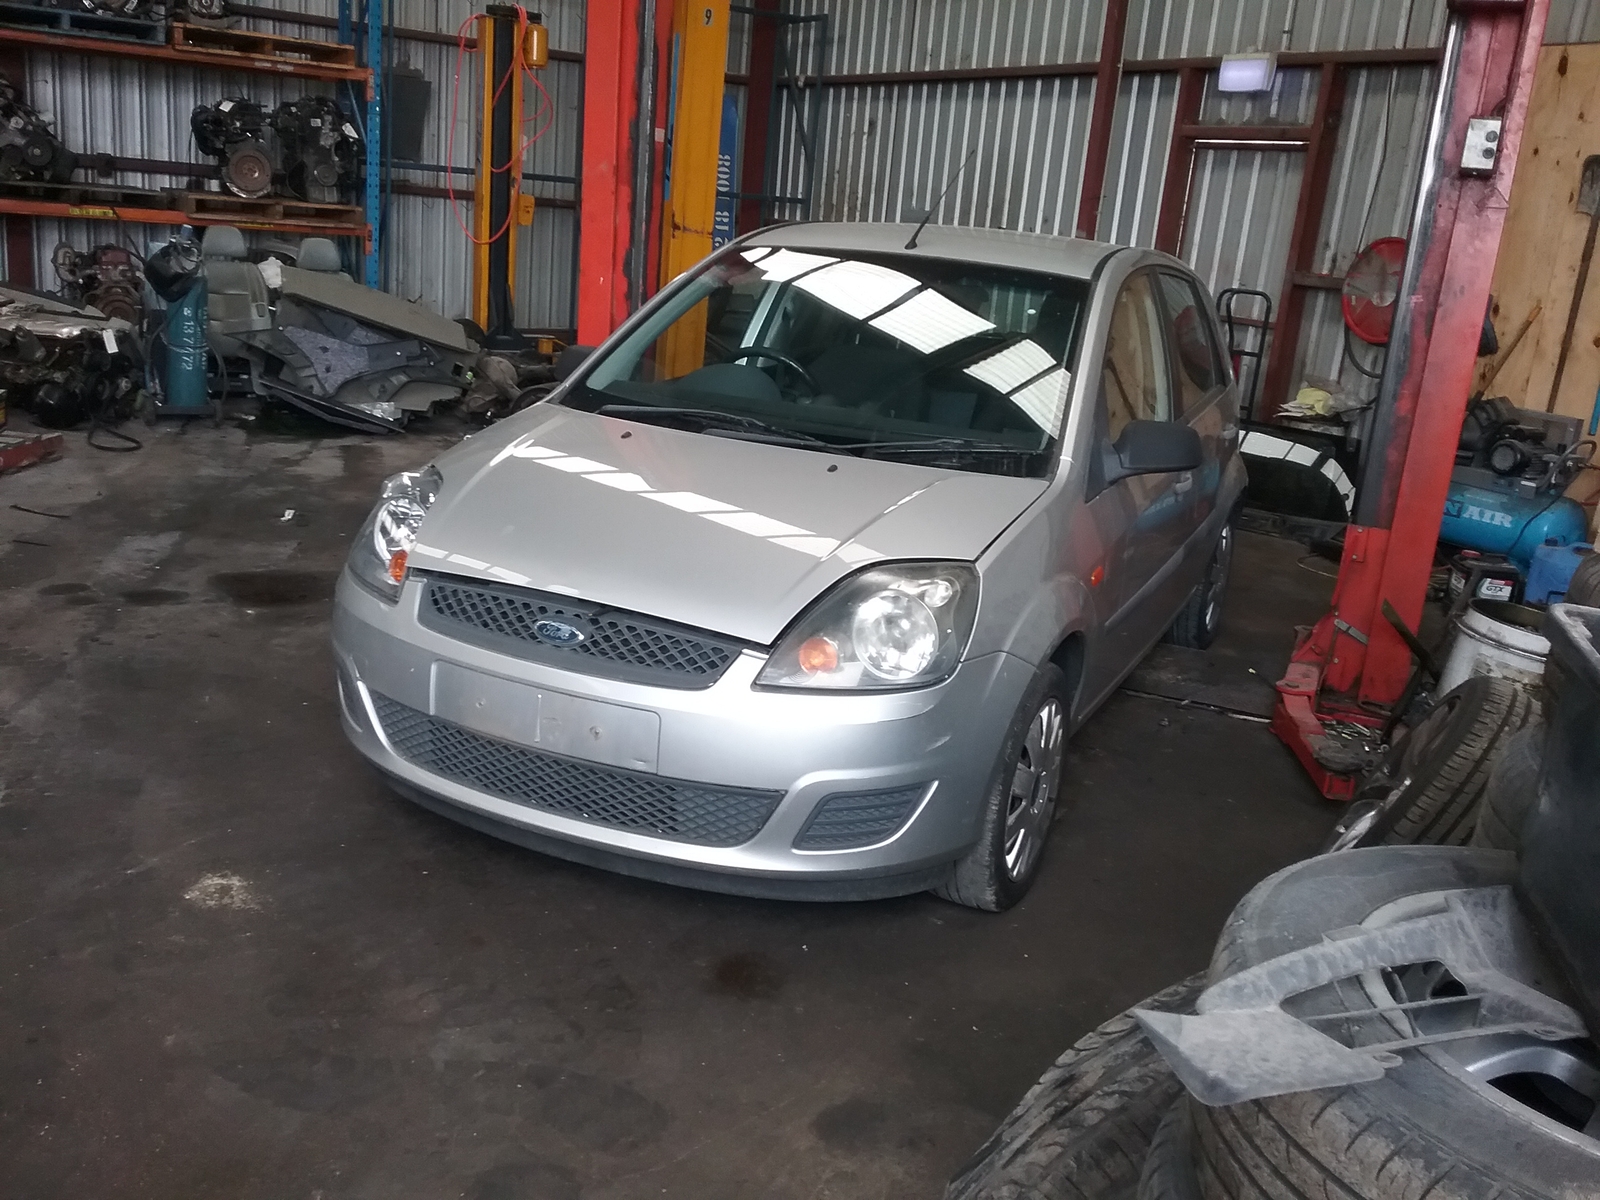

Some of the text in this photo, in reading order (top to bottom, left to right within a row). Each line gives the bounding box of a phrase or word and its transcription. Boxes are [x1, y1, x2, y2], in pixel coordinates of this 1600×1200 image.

[705, 8, 712, 26] 9
[1462, 505, 1513, 528] AIR
[1486, 585, 1505, 593] GTX
